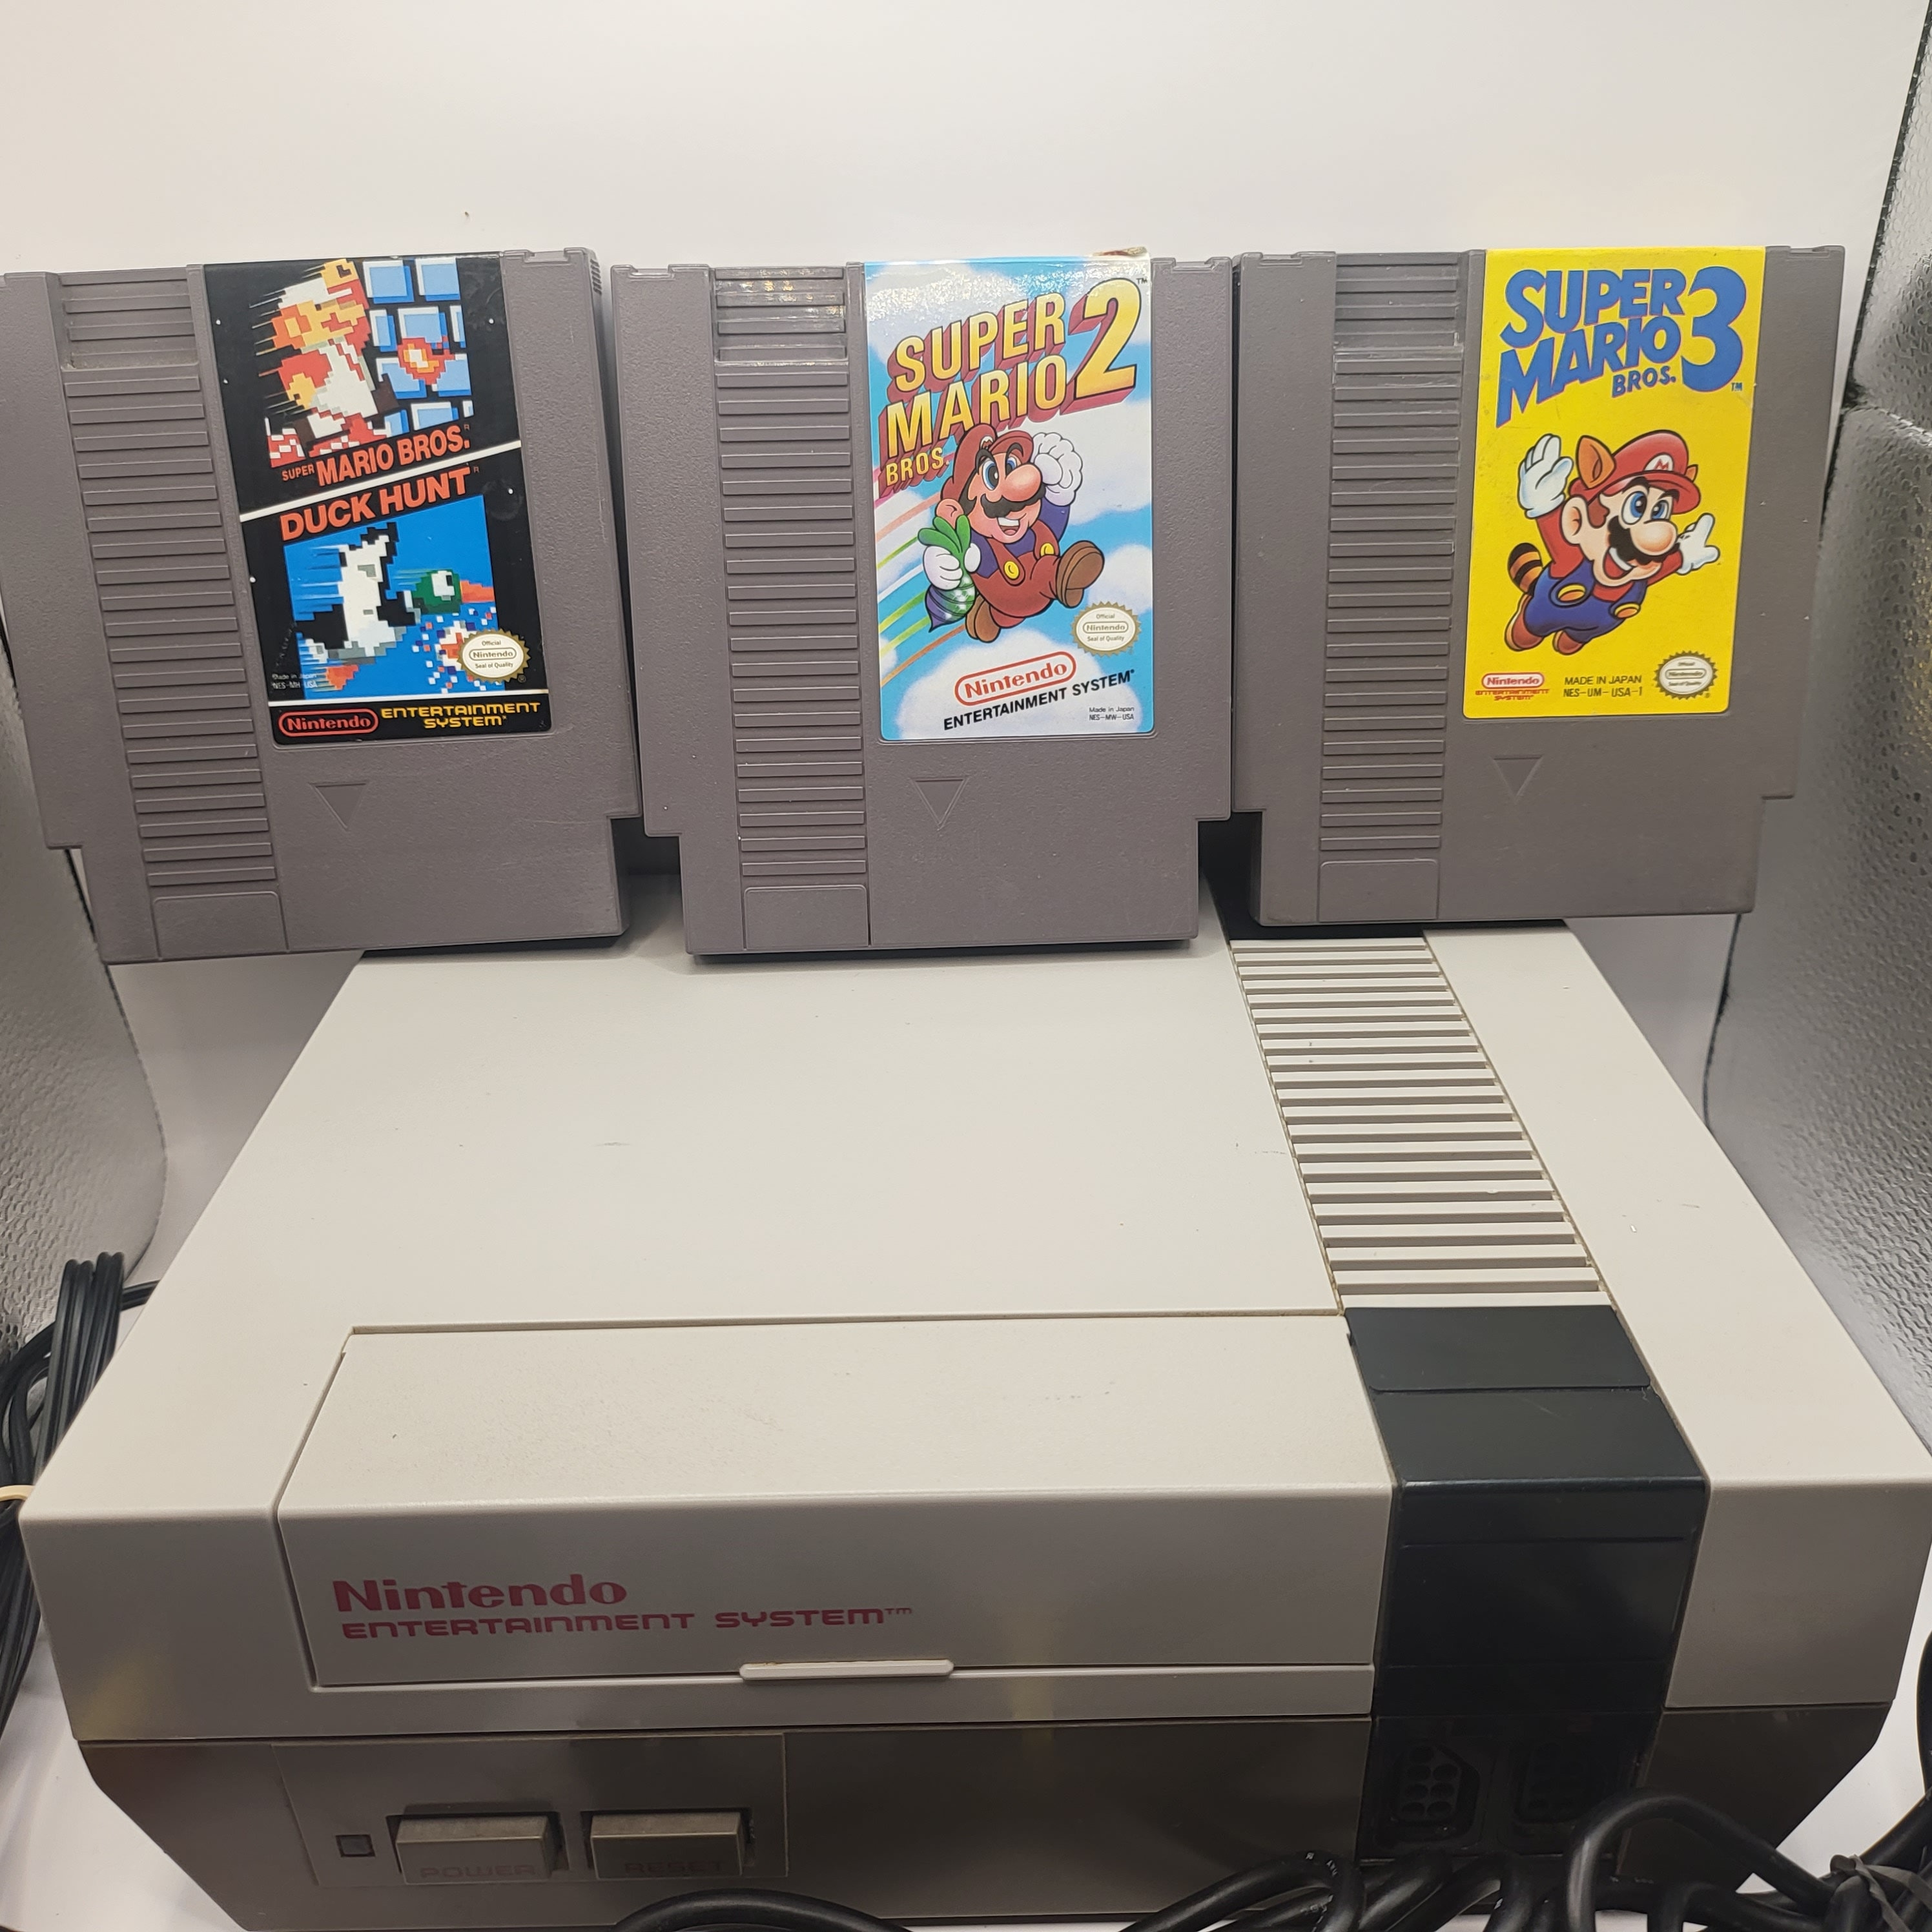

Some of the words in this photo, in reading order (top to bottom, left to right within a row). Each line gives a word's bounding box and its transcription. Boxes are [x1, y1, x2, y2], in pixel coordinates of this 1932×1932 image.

[1500, 269, 1685, 349] SUPER
[1681, 265, 1747, 392] 3
[889, 292, 1066, 395] SUPER
[1065, 277, 1141, 409] 2
[1495, 316, 1681, 428] MARIO
[1611, 365, 1676, 398] BROS.
[882, 355, 1067, 460] MARIO
[282, 464, 314, 482] SUPER
[316, 444, 394, 486] MARIO
[396, 425, 470, 466] BROS.
[882, 446, 950, 491] BROS.
[280, 493, 375, 541] DUCK
[378, 466, 471, 515] HUNT
[964, 663, 1067, 699] Nintendo
[1486, 676, 1540, 686] Nintendo
[1565, 676, 1594, 685] MADE
[1596, 675, 1607, 684] IN
[1608, 675, 1642, 684] JAPAN
[287, 715, 371, 730] Nintendo
[380, 702, 540, 719] ENTERTAINMENT
[943, 687, 1067, 730] ENTERTAINMENT
[333, 1574, 627, 1612] Nintendo
[342, 1613, 695, 1639] ENTERTAINMENT
[420, 1864, 537, 1879] POWER
[624, 1860, 724, 1875] RESET
